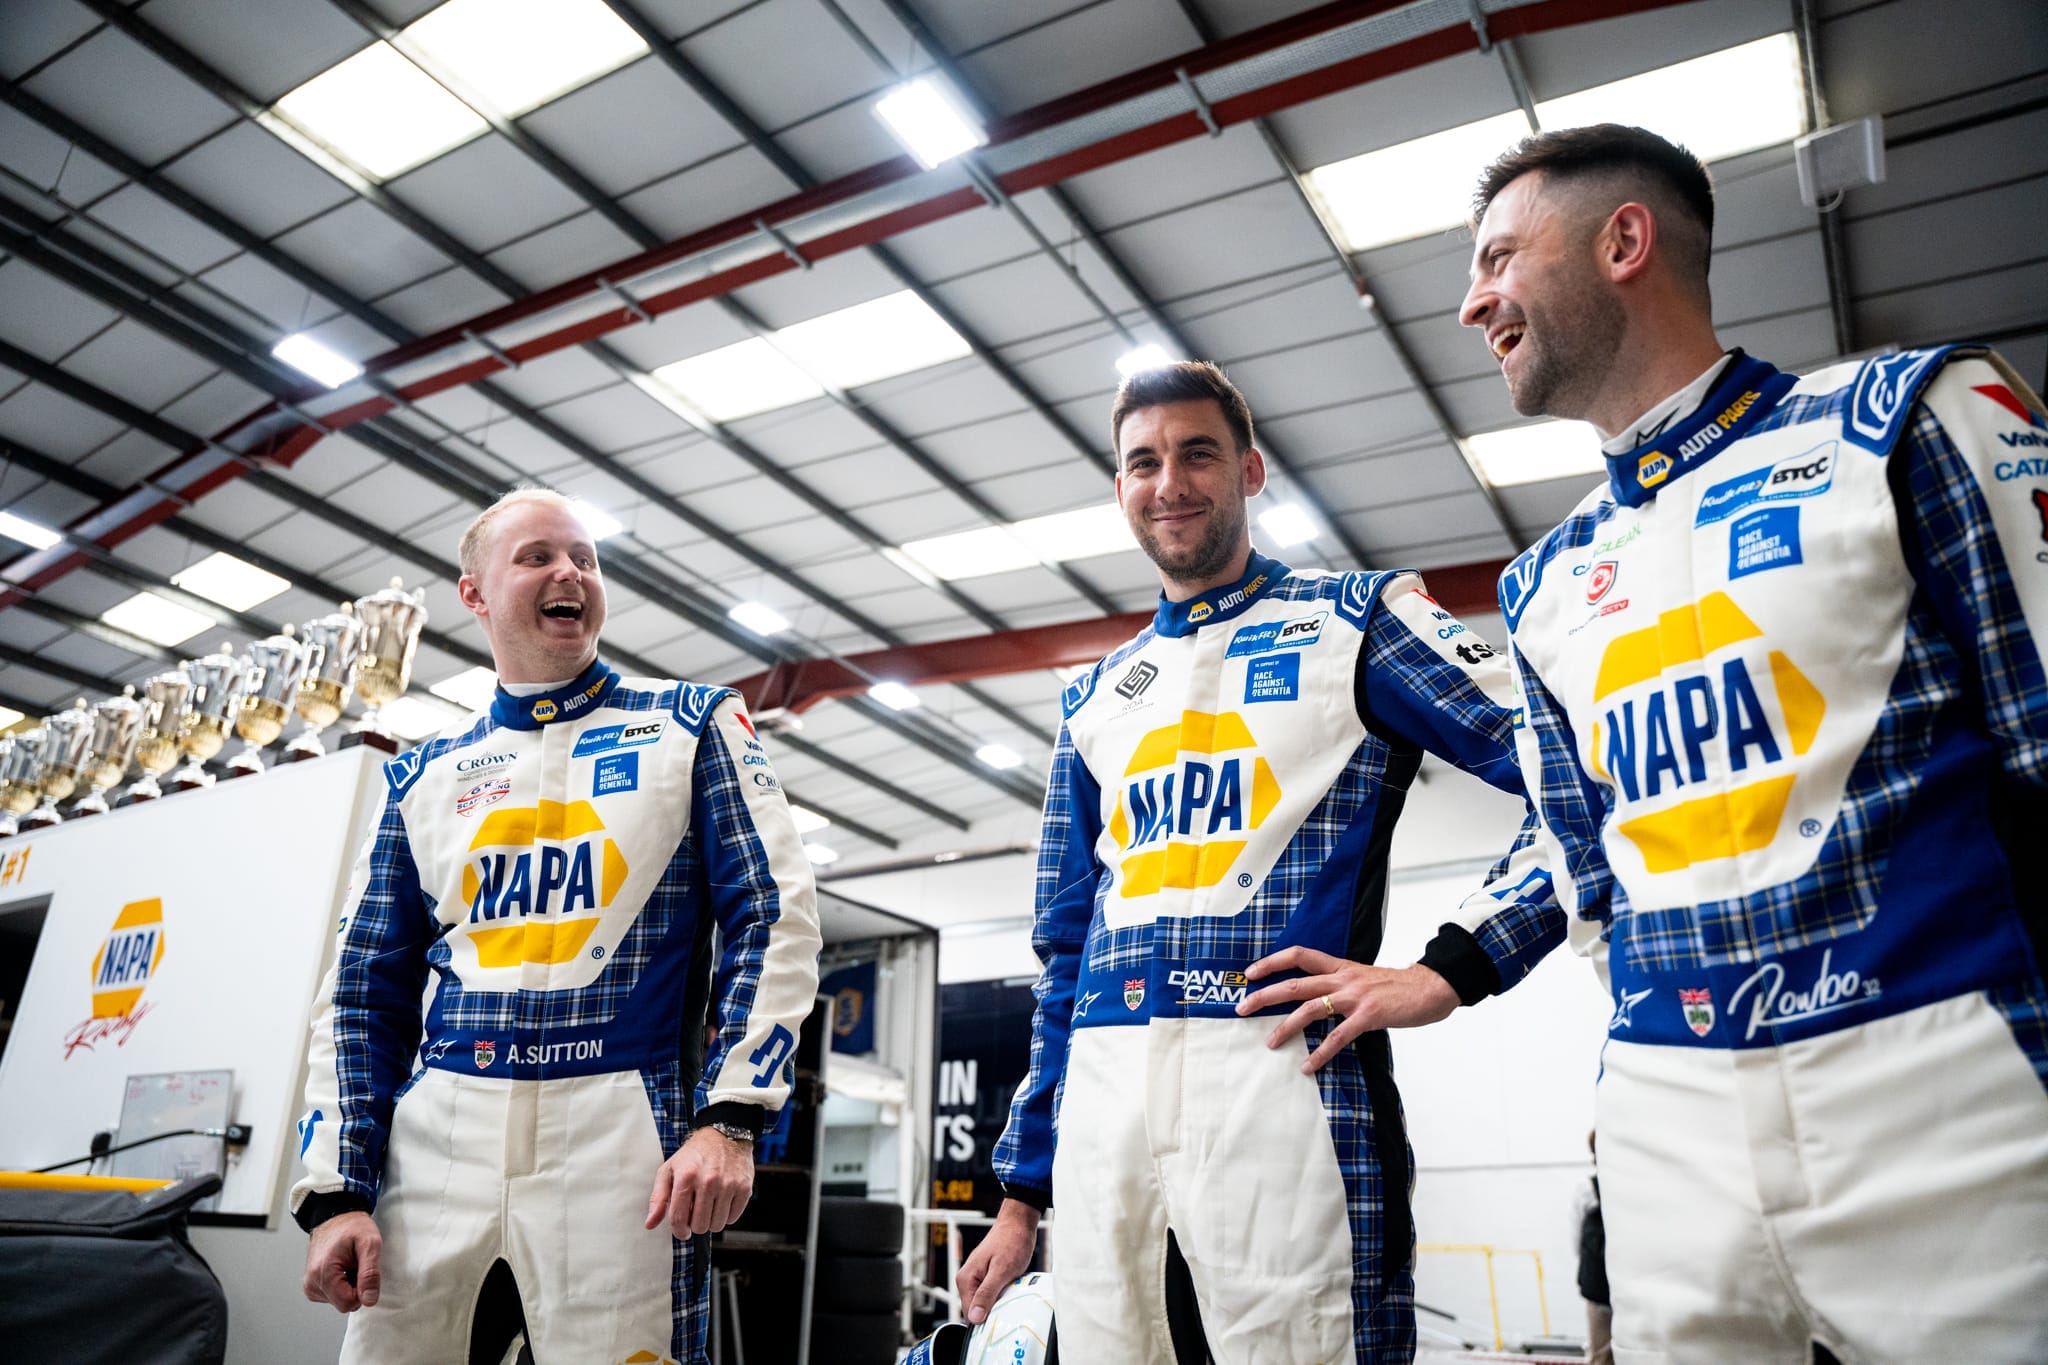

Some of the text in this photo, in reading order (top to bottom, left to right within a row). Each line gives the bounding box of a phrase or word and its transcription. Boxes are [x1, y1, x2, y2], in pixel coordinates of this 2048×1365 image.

[1642, 390, 1762, 479] NAPA AUTO PARTS
[1772, 456, 1829, 485] BTCC
[1192, 574, 1268, 619] NAPA AUTO PARTS
[1282, 619, 1320, 637] BTCC
[1456, 643, 1503, 664] ts
[1253, 678, 1285, 688] AGAINST
[1254, 671, 1273, 680] RACE
[1251, 686, 1291, 697] DEMENTIA
[535, 705, 555, 716] NAPA
[563, 692, 589, 712] AUTO
[625, 723, 661, 738] BTCC
[1606, 657, 1782, 803] NAPA
[743, 754, 769, 767] CATA
[599, 771, 627, 783] AGAINST
[600, 766, 617, 776] RACE
[598, 779, 632, 791] DEMENTIA
[1127, 758, 1242, 850] NAPA
[471, 841, 595, 923] NAPA
[99, 930, 155, 986] NAPA
[1167, 970, 1225, 988] DAN
[1185, 986, 1247, 1003] CAM
[505, 1039, 603, 1065] A.SUTTON
[938, 1059, 977, 1106] IN
